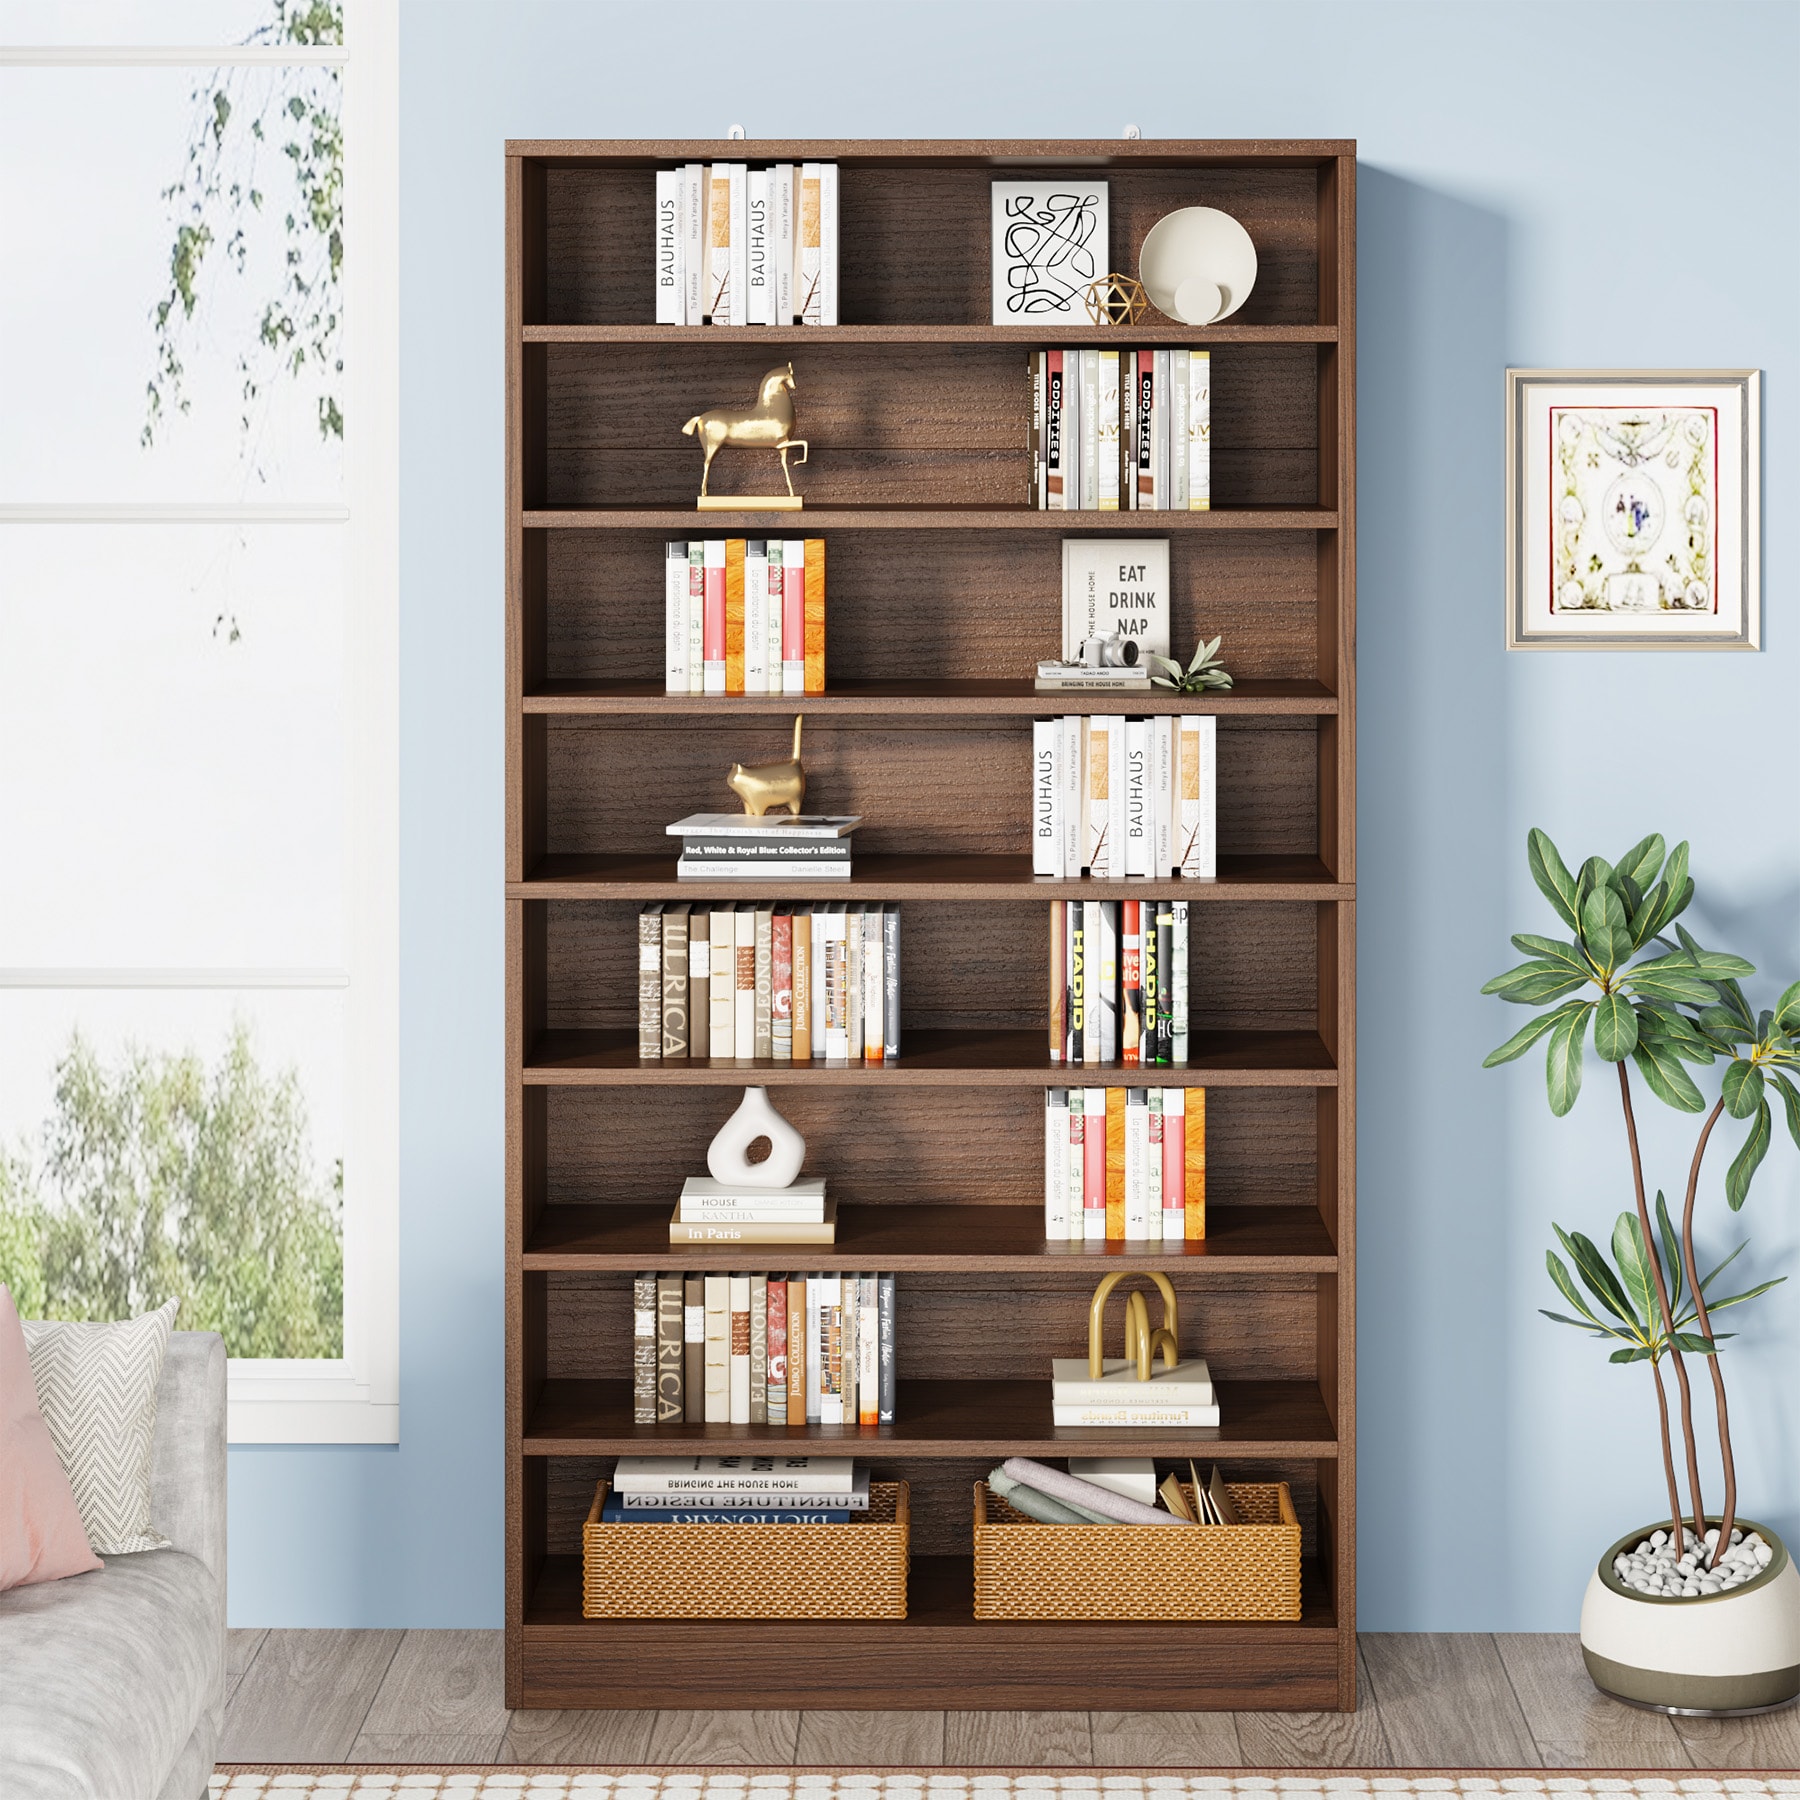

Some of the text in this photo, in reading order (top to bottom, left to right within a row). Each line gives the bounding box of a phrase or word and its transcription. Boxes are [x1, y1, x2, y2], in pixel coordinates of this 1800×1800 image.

[660, 200, 674, 286] BAUHAUS
[751, 200, 765, 286] BAUHAUS
[782, 219, 790, 239] Hanya
[1050, 380, 1061, 460] ODDITIES
[1087, 384, 1096, 435] mockingbird
[1141, 380, 1151, 460] ODDITIES
[1176, 384, 1186, 435] mockingbird
[1087, 458, 1094, 467] to
[1177, 458, 1184, 467] to
[1119, 566, 1146, 582] EAT
[1110, 592, 1156, 608] DRINK
[1118, 619, 1148, 635] NAP
[1039, 750, 1052, 837] BAUHAUS
[1129, 750, 1143, 837] BAUHAUS
[1161, 771, 1169, 791] Hanya
[684, 865, 738, 874] The Challenge
[686, 846, 702, 855] Red,
[704, 846, 727, 854] White
[737, 847, 757, 856] Royal
[779, 847, 818, 855] Collector's
[820, 847, 846, 855] Edition
[792, 865, 844, 873] Danielle Steel
[1070, 853, 1076, 861] To
[1161, 853, 1167, 861] To
[664, 924, 687, 1056] ULRICA
[757, 921, 771, 1038] ELEONORA
[795, 946, 807, 1031] JUMBO COLLECTION
[1073, 930, 1083, 1030] HADID
[1146, 930, 1156, 1030] HADID
[688, 1228, 741, 1239] In Paris
[702, 1212, 754, 1220] KANTHA
[658, 1290, 683, 1421] ULRICA
[752, 1286, 766, 1403] ELEONORA
[790, 1312, 801, 1396] JUMBO COLLECTION
